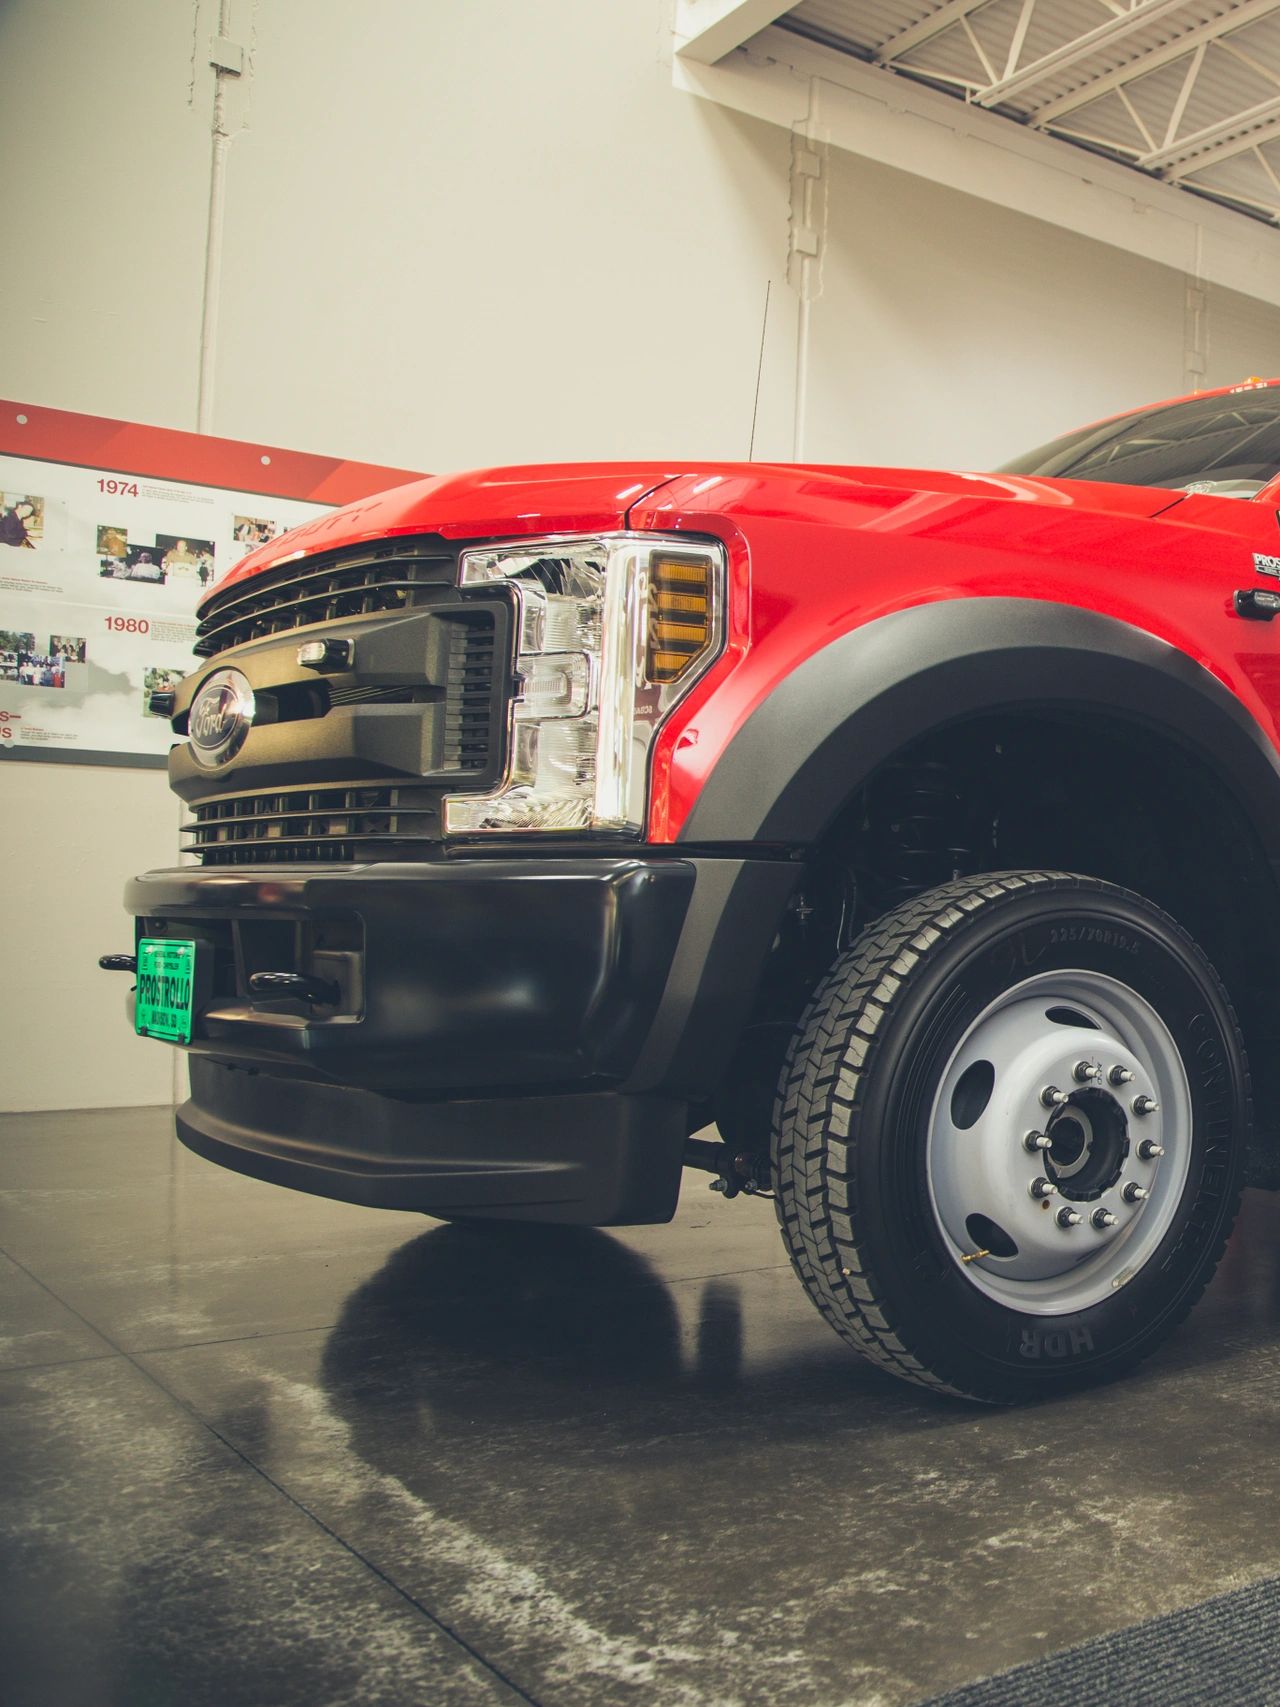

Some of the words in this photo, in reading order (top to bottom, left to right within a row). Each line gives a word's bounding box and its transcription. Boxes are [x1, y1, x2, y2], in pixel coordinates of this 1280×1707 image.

[97, 479, 139, 498] 1974
[104, 616, 150, 634] 1980
[196, 696, 228, 738] Ford
[139, 974, 191, 1011] PROSTROLLO
